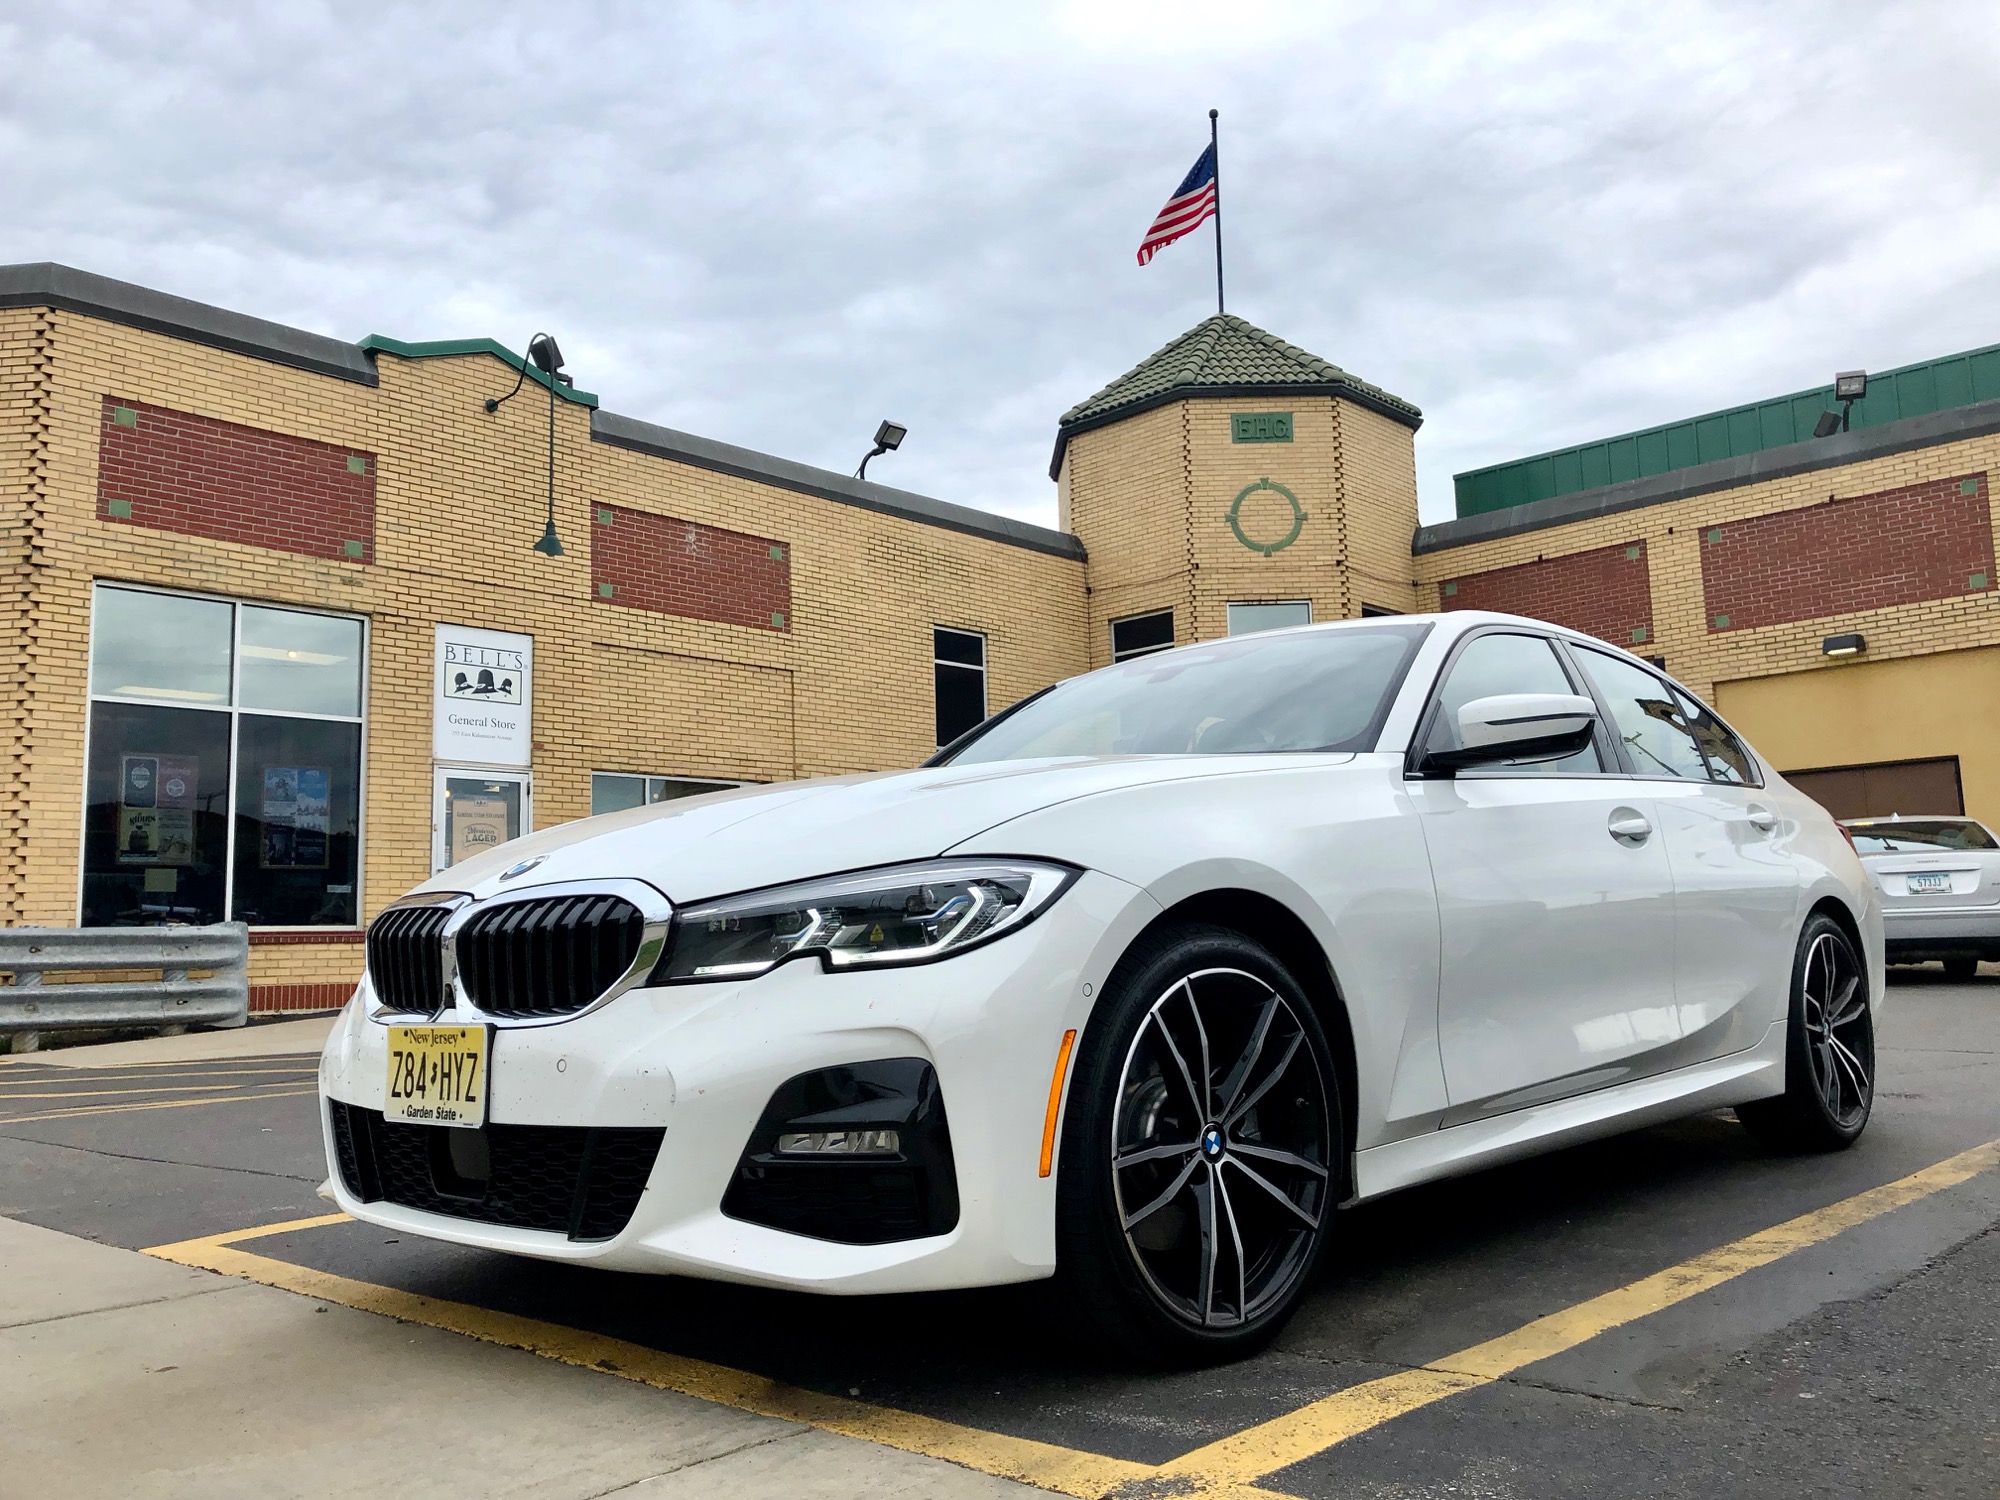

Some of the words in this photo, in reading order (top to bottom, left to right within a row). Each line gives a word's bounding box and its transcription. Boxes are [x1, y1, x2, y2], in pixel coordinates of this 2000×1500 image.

[445, 645, 523, 670] BELL'S
[448, 713, 487, 727] General
[490, 717, 516, 730] Store
[465, 833, 497, 844] LAGER
[409, 1029, 430, 1044] New
[430, 1029, 459, 1048] Jersey
[391, 1051, 427, 1099] Z84
[438, 1052, 478, 1102] HYZ
[406, 1104, 433, 1119] Garden
[435, 1106, 457, 1120] State
